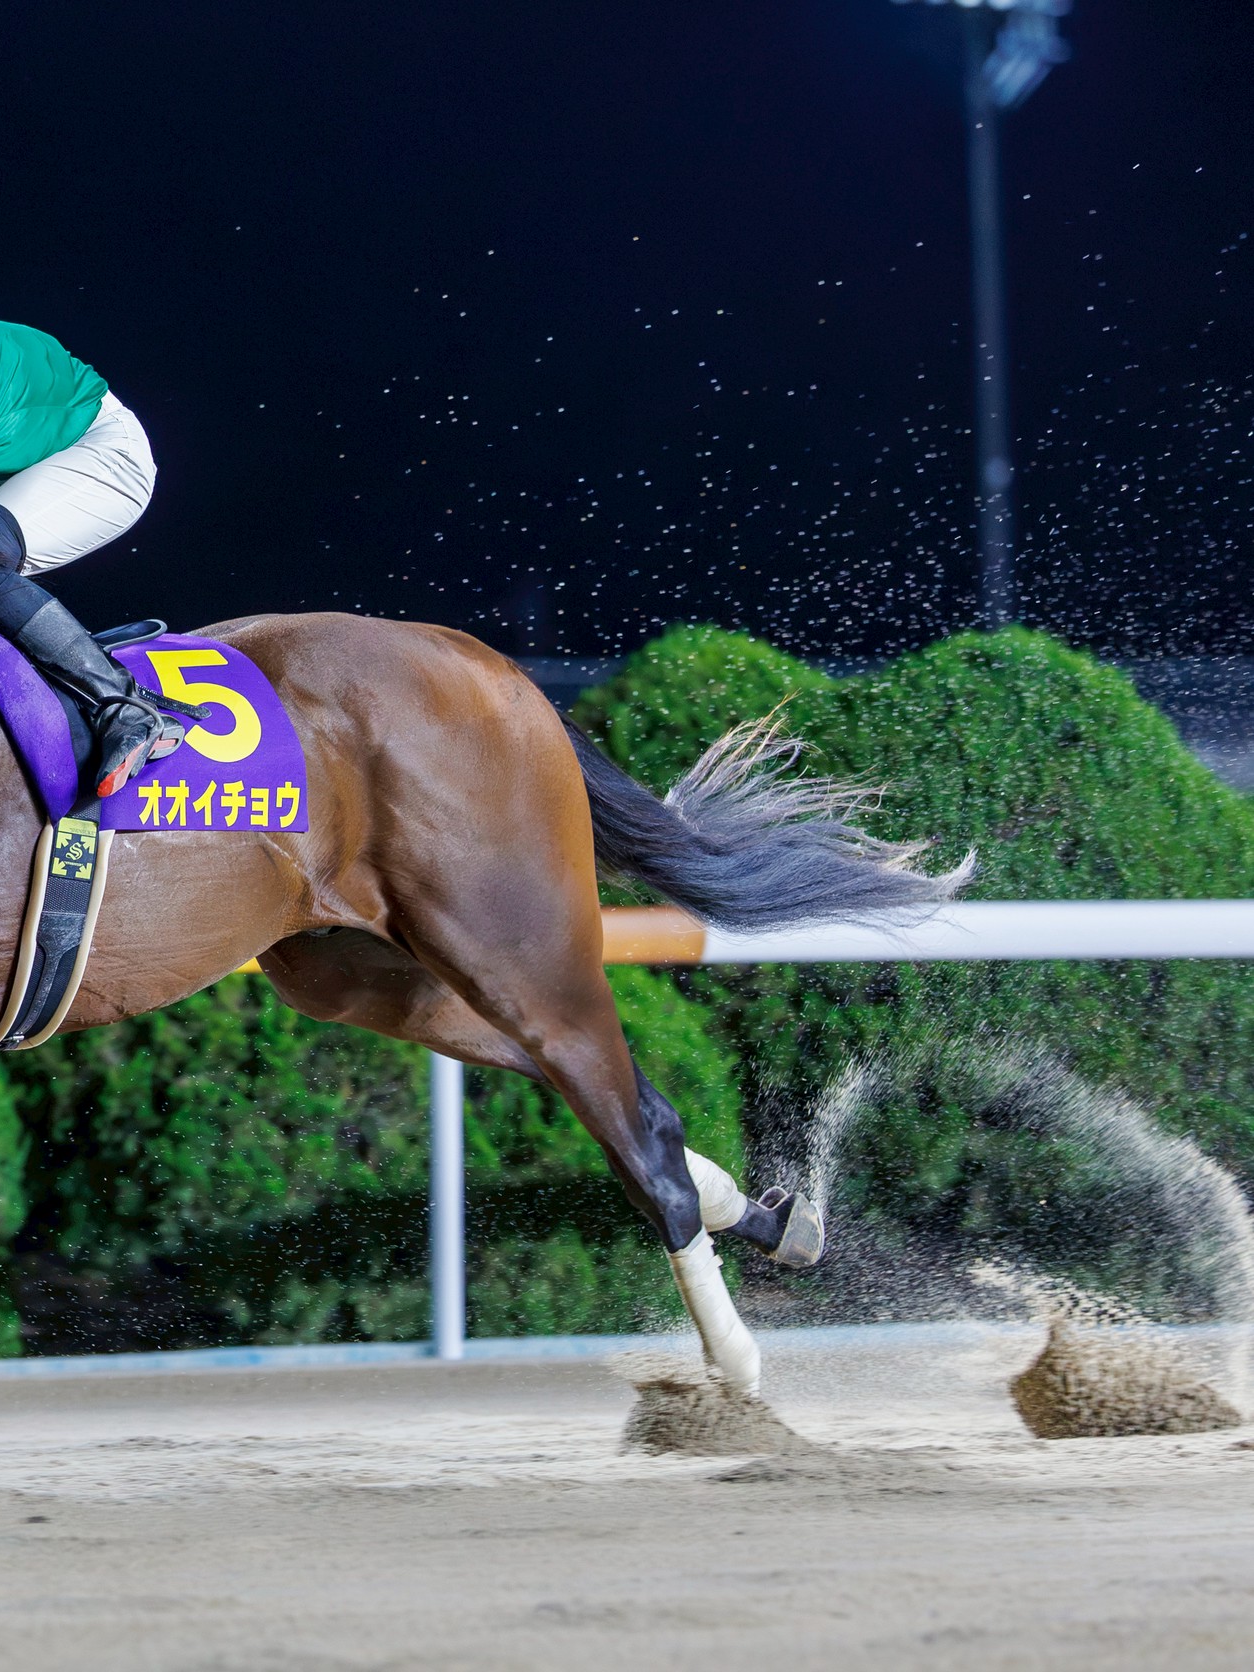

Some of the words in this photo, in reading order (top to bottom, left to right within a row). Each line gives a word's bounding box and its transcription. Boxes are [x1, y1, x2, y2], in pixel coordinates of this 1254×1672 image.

[146, 649, 262, 763] 5
[137, 779, 300, 828] オオイチョウ
